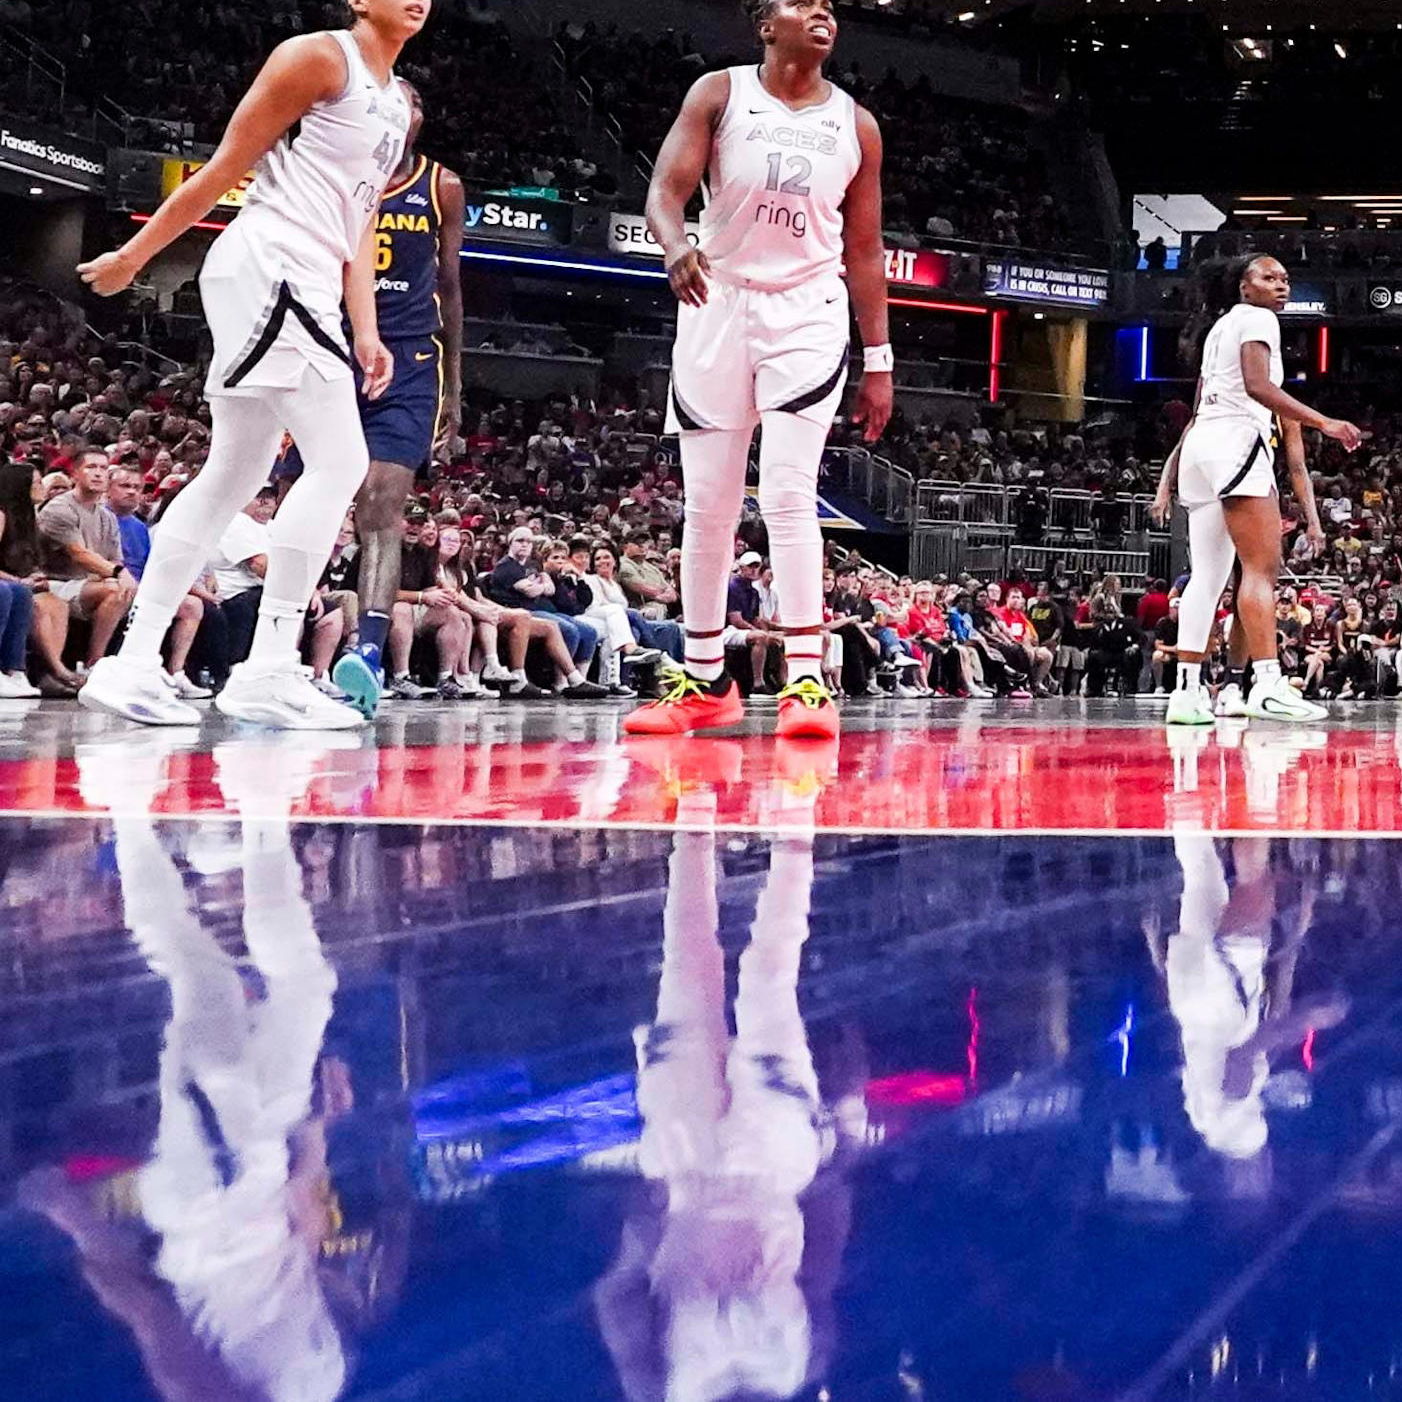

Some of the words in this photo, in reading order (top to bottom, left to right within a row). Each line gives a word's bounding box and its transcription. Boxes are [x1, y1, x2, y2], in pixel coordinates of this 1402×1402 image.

[0, 129, 47, 159] Fanatics
[746, 123, 838, 155] ACES
[765, 152, 813, 197] 12
[755, 201, 806, 238] ring
[1019, 267, 1033, 279] YOU
[1078, 273, 1091, 285] YOU
[1051, 283, 1067, 296] CALL
[1078, 286, 1094, 299] TEXT
